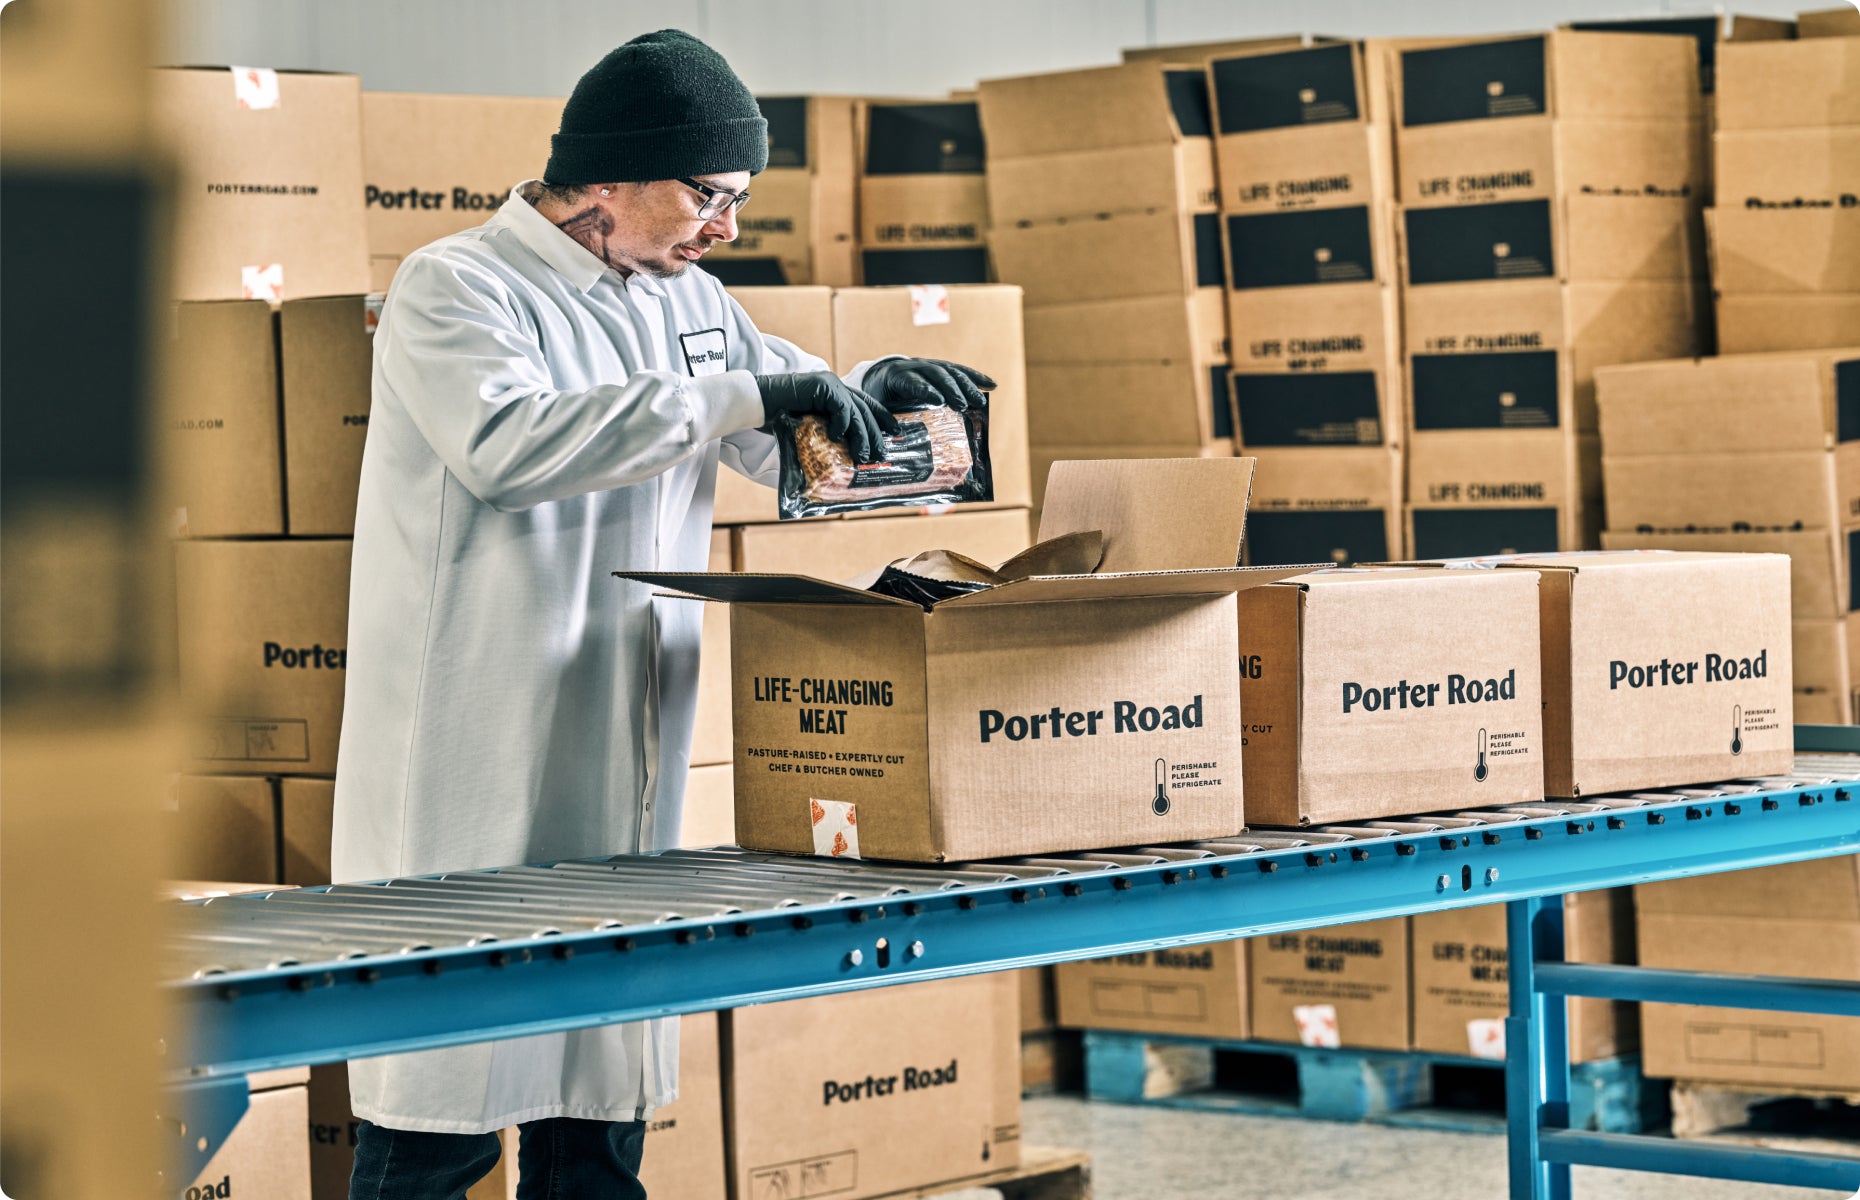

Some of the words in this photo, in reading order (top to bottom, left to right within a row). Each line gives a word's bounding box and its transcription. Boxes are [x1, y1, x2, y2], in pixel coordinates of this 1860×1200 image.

[365, 184, 446, 210] Porter
[1610, 657, 1698, 690] Porter
[1705, 648, 1767, 682] Road
[754, 677, 894, 707] LIFE-CHANGING
[1342, 679, 1440, 713] Porter
[1448, 668, 1516, 705] Road
[979, 706, 1104, 743] Porter
[1113, 694, 1203, 734] Road
[1744, 708, 1776, 716] PERISHABLE
[799, 708, 848, 734] MEAT
[1744, 724, 1779, 732] REFRIGERATE
[1251, 725, 1273, 733] CUT
[1490, 732, 1526, 740] PERISHABLE
[1490, 741, 1512, 749] PLEASE
[1490, 748, 1529, 757] REFRIGERATE
[747, 747, 827, 761] PASTURE-RAISED
[835, 752, 884, 764] EXPERTLY
[885, 755, 905, 765] CUT
[769, 763, 793, 773] CHEF
[795, 764, 801, 774] &
[803, 765, 848, 776] BUTCHER
[849, 767, 885, 778] OWNED
[1171, 762, 1217, 771] PERISHABLE
[1171, 771, 1200, 780] PLEASE
[1171, 779, 1222, 789] REFRIGERATE
[823, 1075, 898, 1106] Porter
[903, 1058, 958, 1092] Road
[185, 1174, 231, 1200] oad
